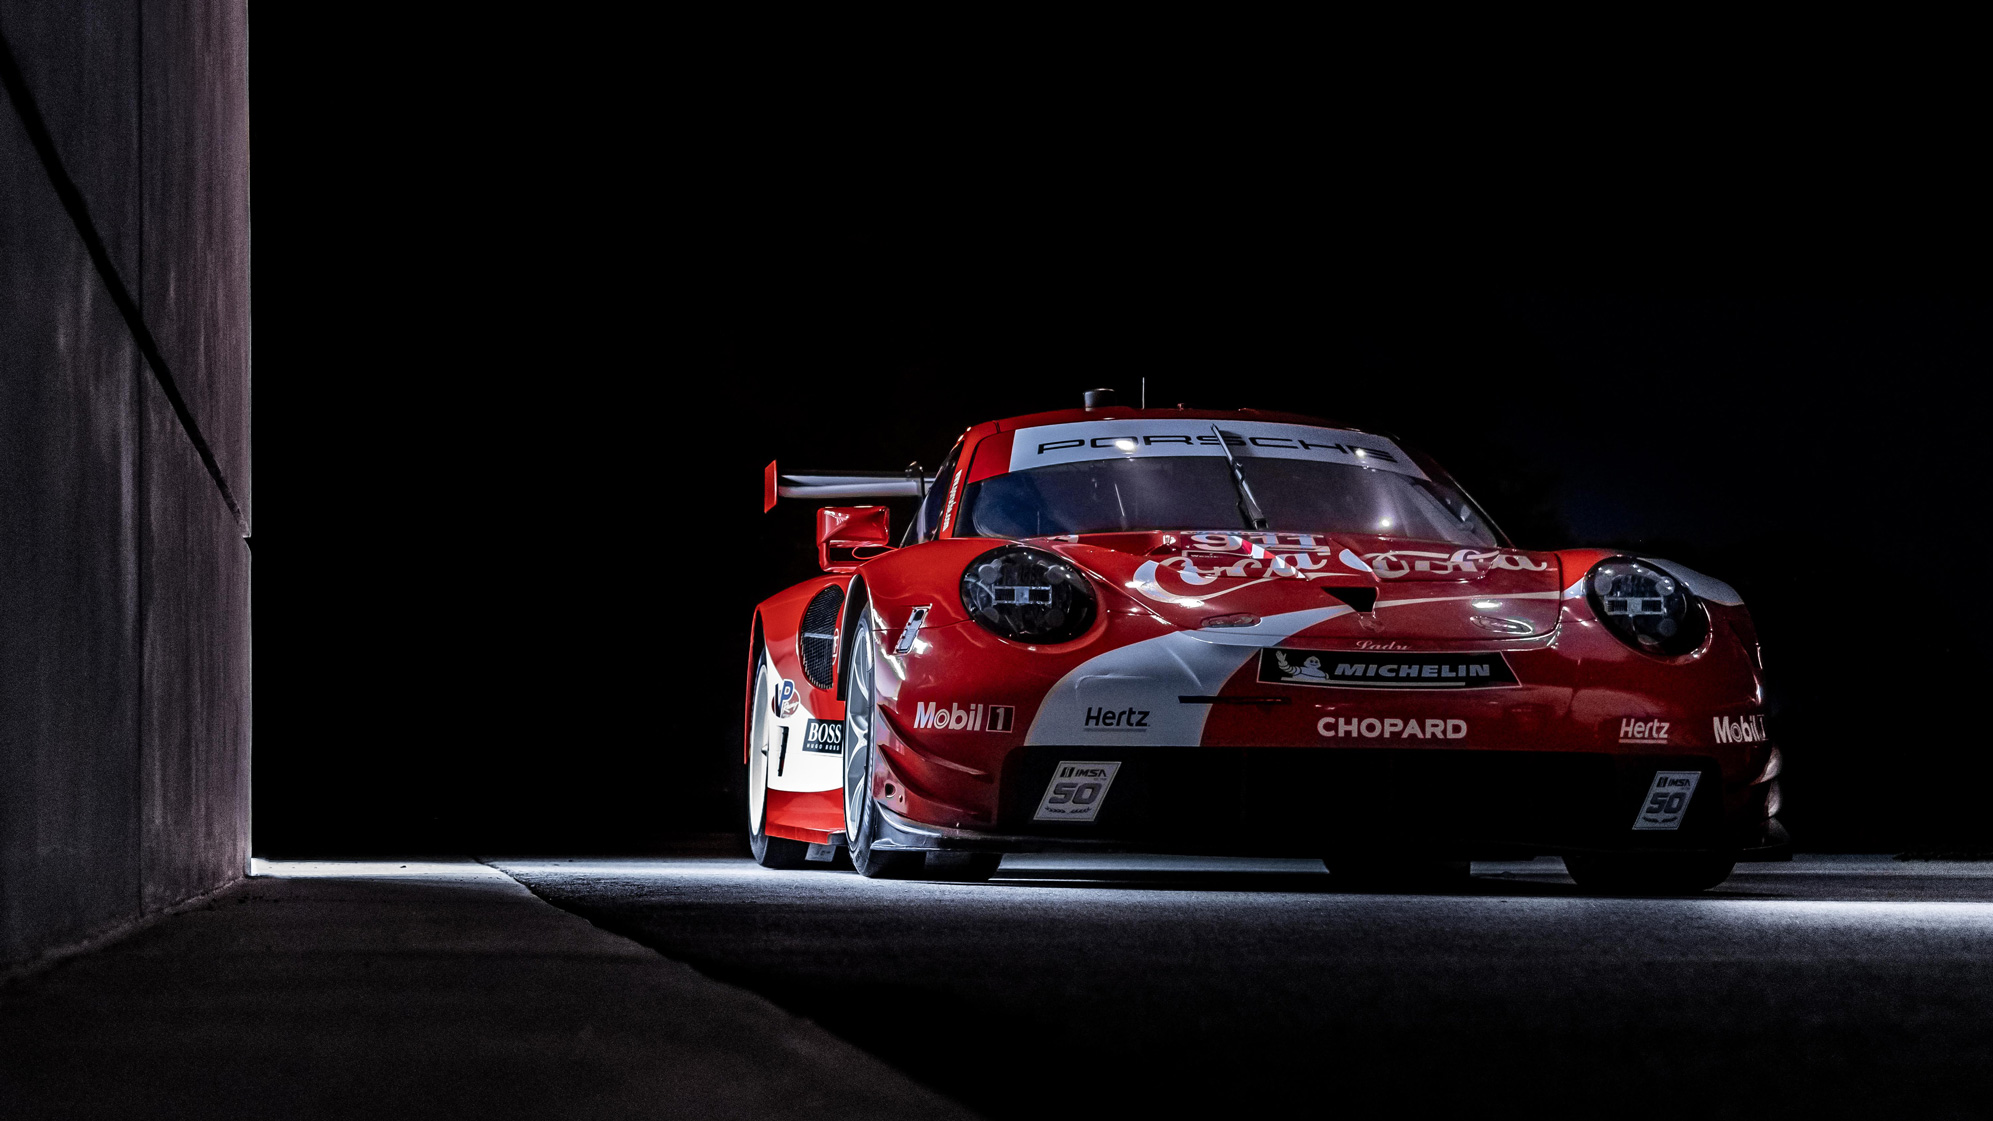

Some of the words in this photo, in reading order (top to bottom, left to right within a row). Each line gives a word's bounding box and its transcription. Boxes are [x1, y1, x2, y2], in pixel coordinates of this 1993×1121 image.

[1038, 435, 1398, 463] PORSCHE
[1334, 663, 1490, 678] MICHELIN
[913, 701, 984, 731] Mobil
[1084, 707, 1150, 727] Hertz
[808, 722, 842, 744] BOSS
[1317, 717, 1467, 739] CHOPARD
[1620, 718, 1670, 738] Hertz
[1713, 715, 1760, 743] Mobil
[1075, 769, 1106, 777] IMSA
[1048, 783, 1102, 804] 50
[1646, 792, 1686, 813] 50
